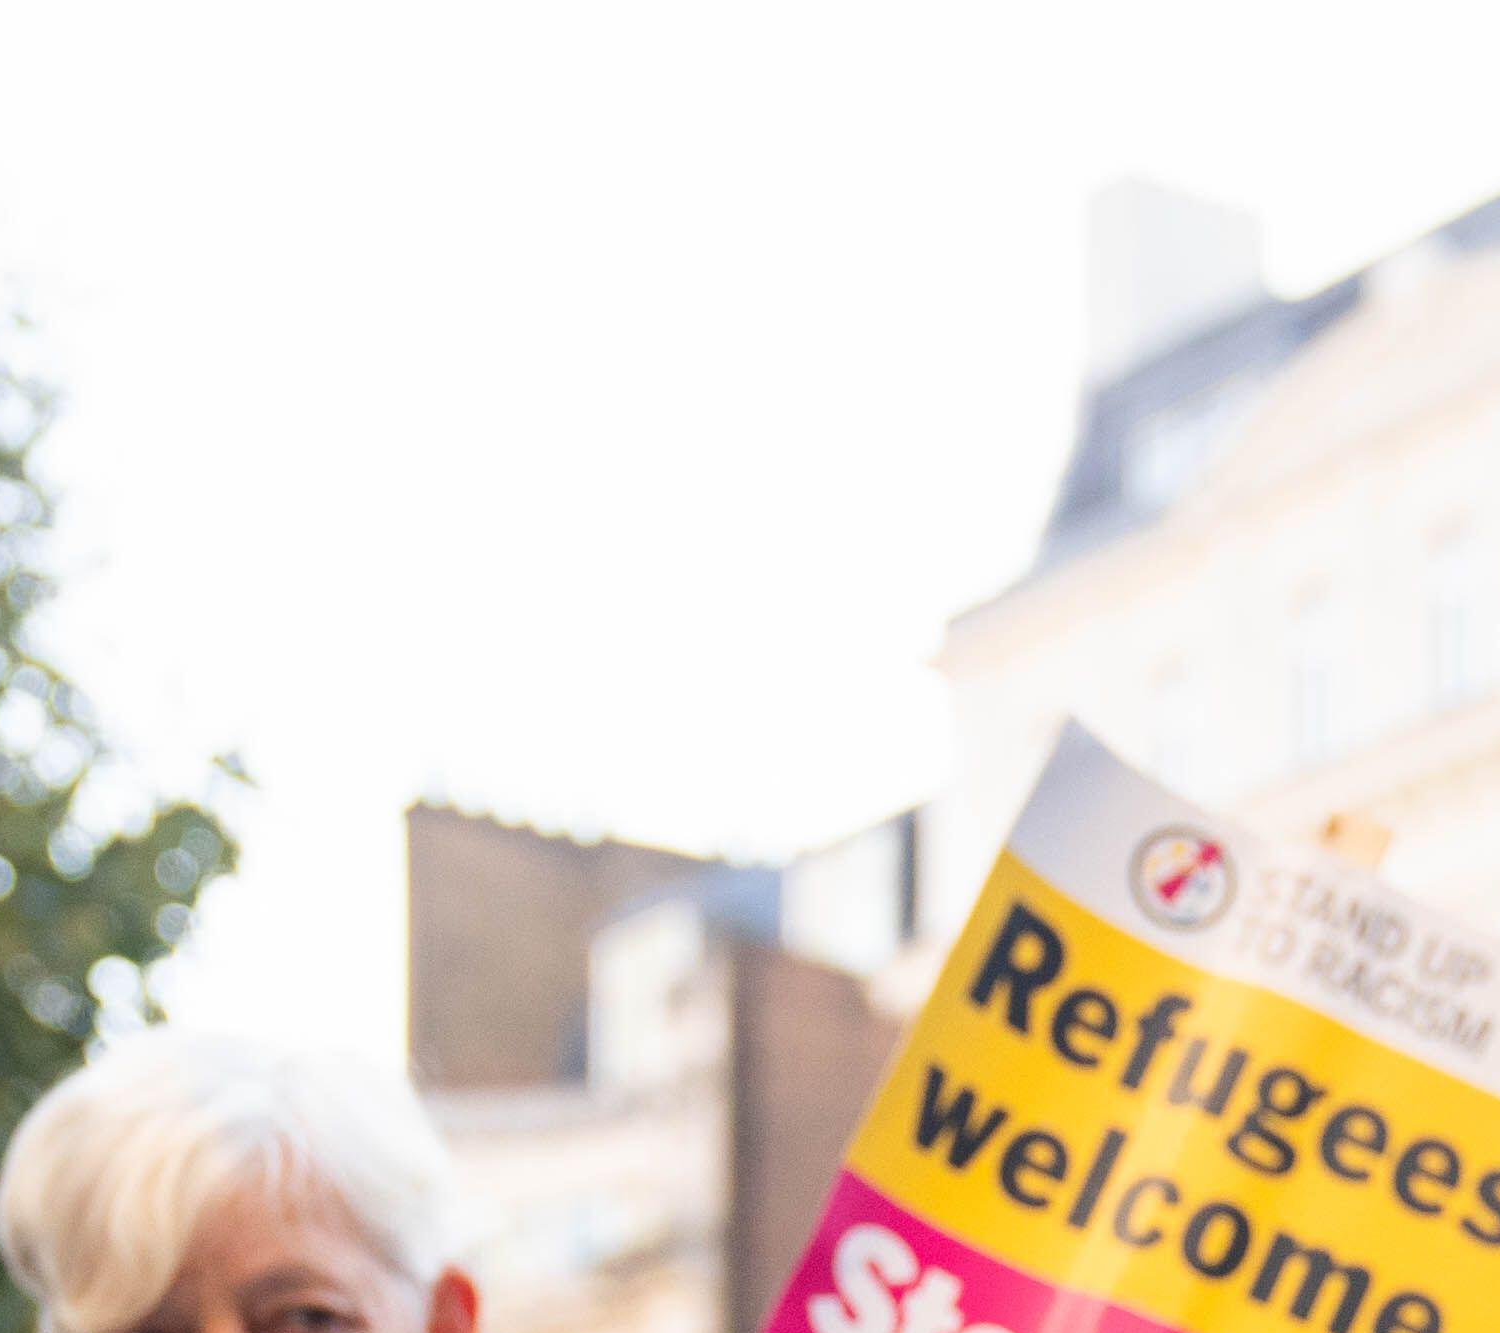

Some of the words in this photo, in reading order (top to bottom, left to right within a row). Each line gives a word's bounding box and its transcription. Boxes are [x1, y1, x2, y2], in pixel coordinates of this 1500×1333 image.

[1234, 912, 1297, 965] TO
[1303, 938, 1495, 1058] RACISM
[1250, 868, 1409, 957] STAND
[1418, 928, 1492, 990] UP
